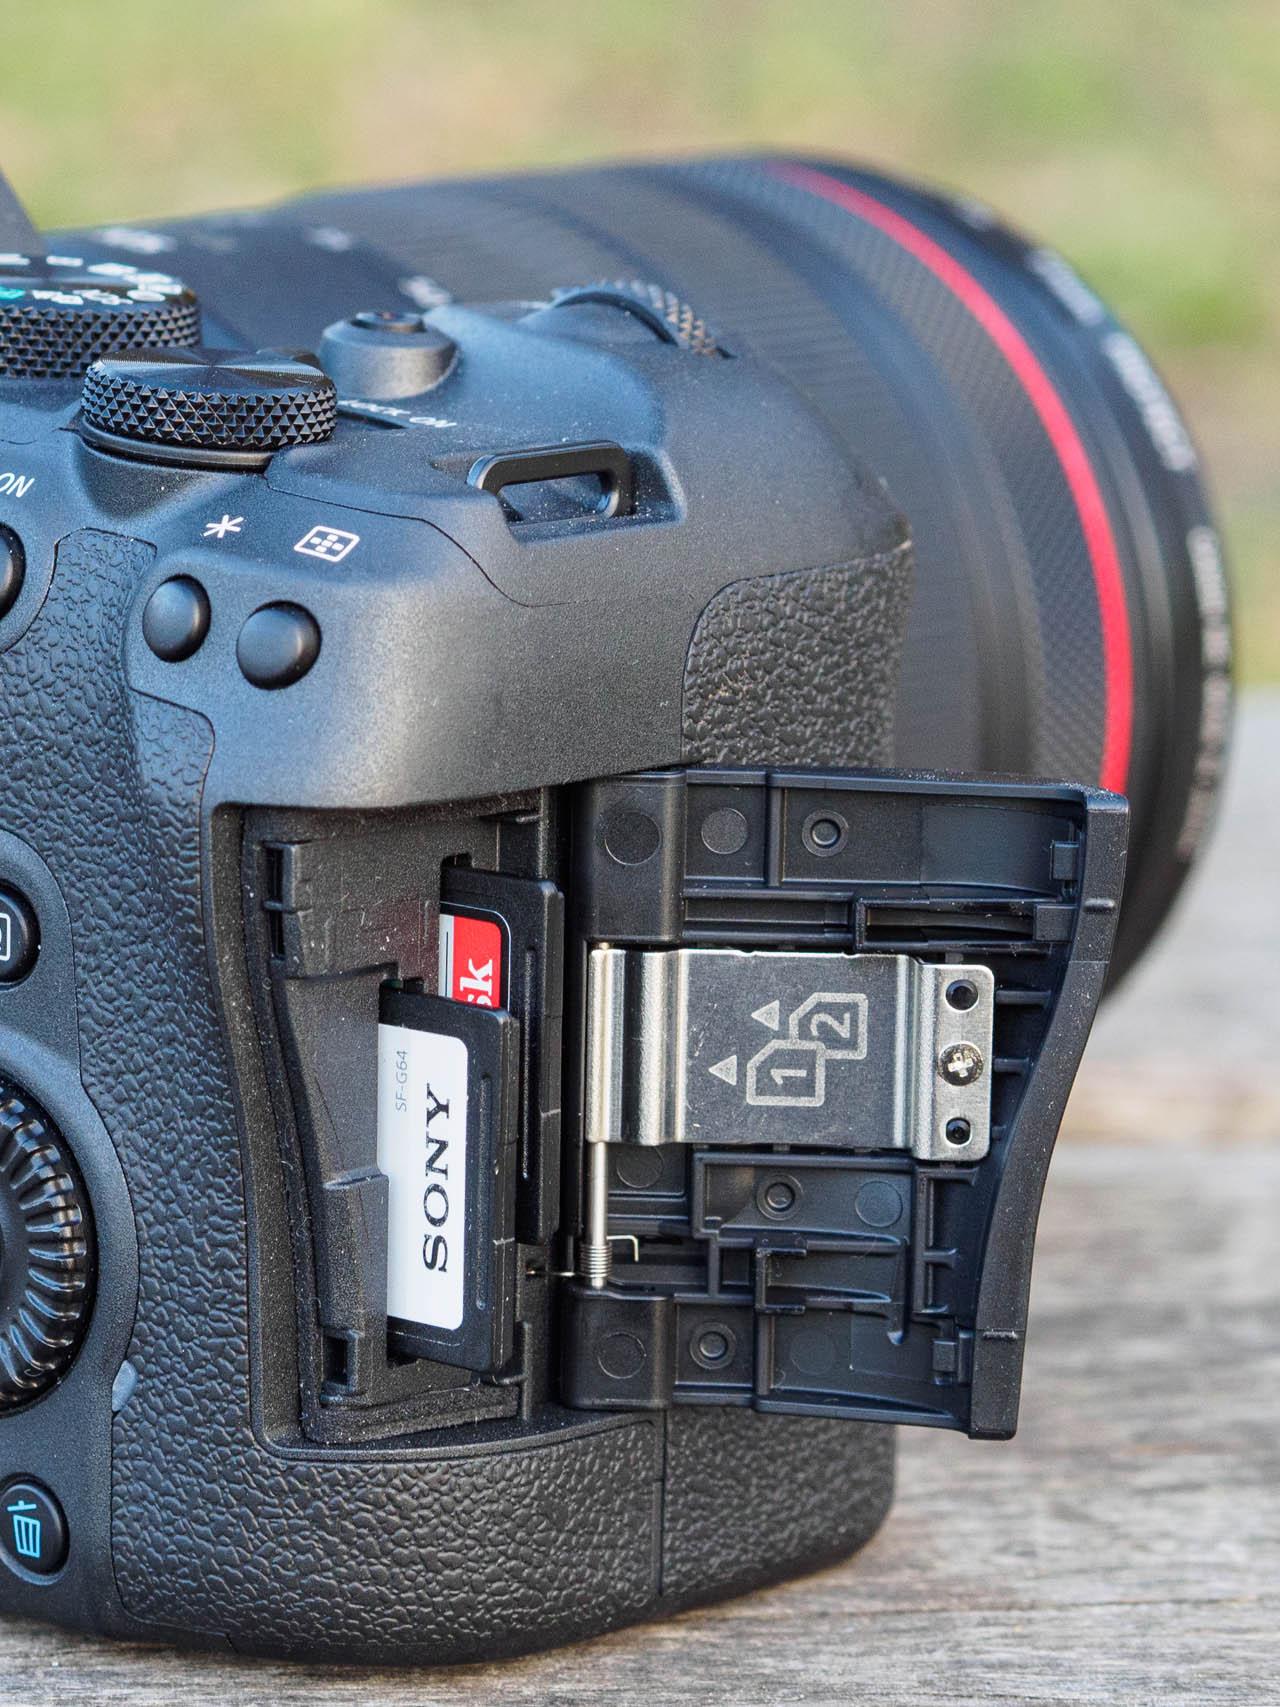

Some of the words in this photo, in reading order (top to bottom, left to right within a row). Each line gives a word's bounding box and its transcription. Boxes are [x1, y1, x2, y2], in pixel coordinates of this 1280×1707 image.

[810, 1012, 851, 1039] 2
[395, 1049, 408, 1113] SF-G64
[770, 1068, 808, 1085] 1
[422, 1082, 451, 1273] SONY
